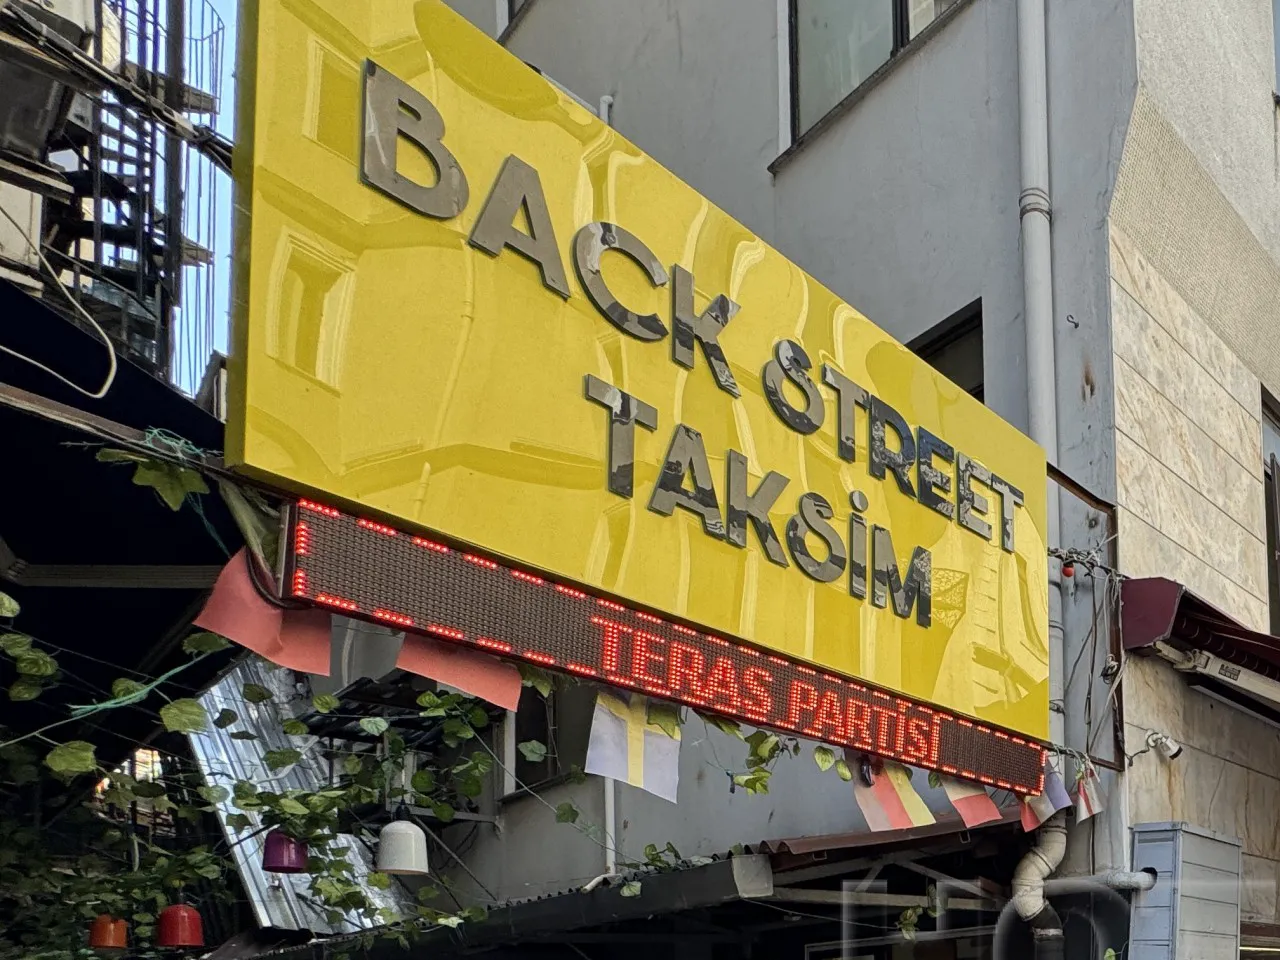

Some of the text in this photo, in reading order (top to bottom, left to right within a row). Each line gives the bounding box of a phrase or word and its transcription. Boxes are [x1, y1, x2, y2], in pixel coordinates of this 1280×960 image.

[359, 59, 1025, 553] BACK STREET
[583, 373, 933, 628] TAKSİM
[591, 615, 773, 716] TERAS
